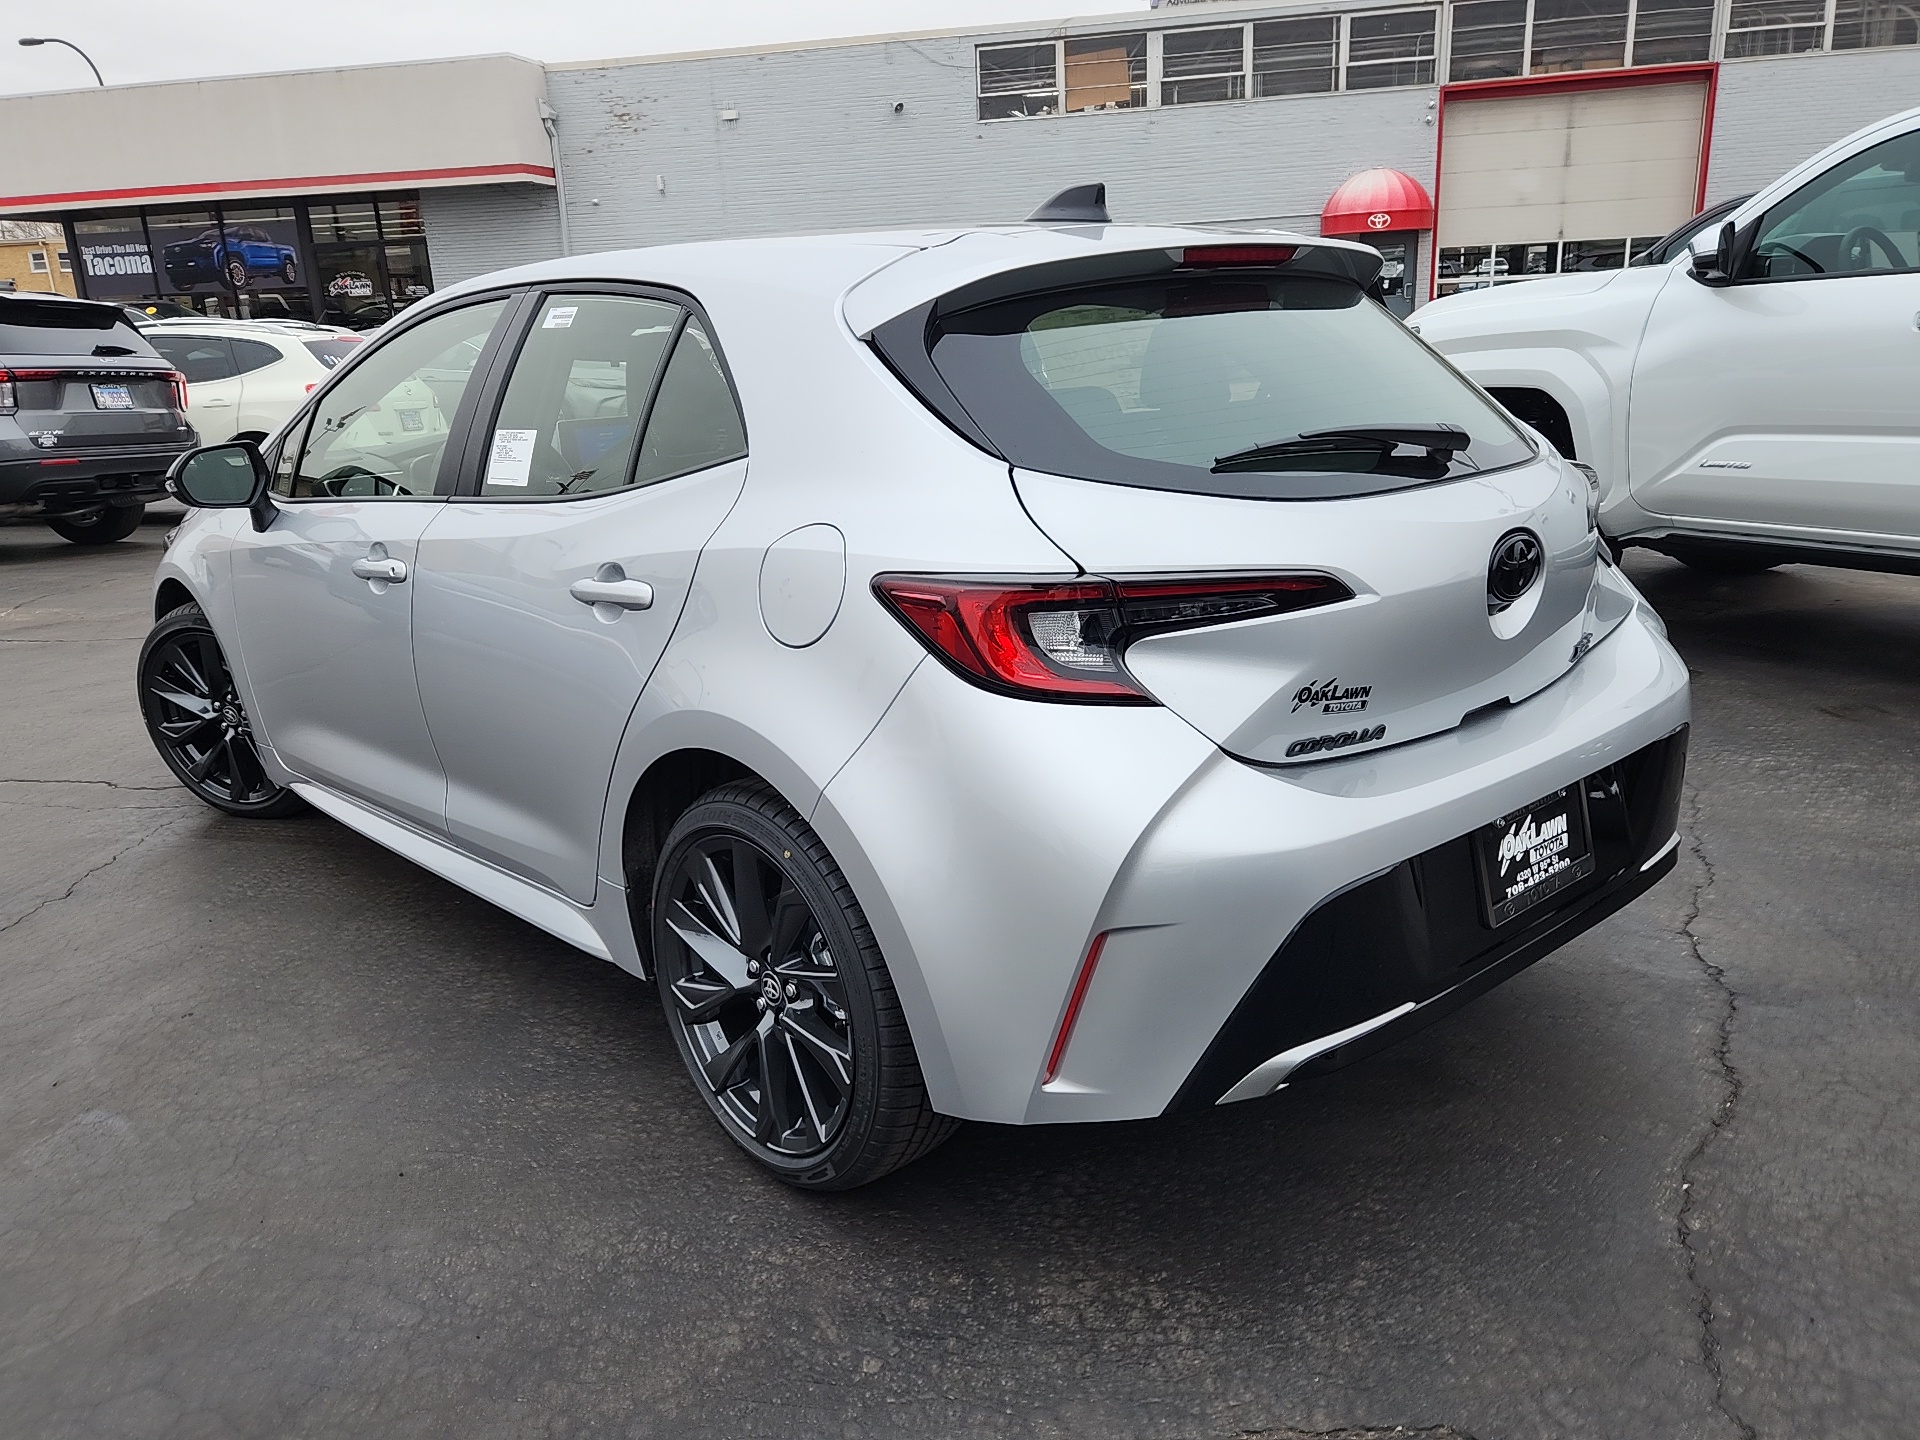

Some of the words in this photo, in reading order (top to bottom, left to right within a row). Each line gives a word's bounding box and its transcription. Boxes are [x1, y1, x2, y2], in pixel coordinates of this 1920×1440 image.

[81, 246, 96, 255] Test
[95, 245, 113, 254] Drive
[112, 244, 125, 253] The
[125, 243, 135, 252] All
[82, 254, 157, 276] Tacoma
[1328, 701, 1362, 712] TOYOTA
[1285, 723, 1387, 757] COROLLA
[1534, 836, 1565, 860] TOYOTA
[1516, 867, 1532, 882] 4320
[1531, 863, 1539, 874] W
[1551, 854, 1559, 865] St
